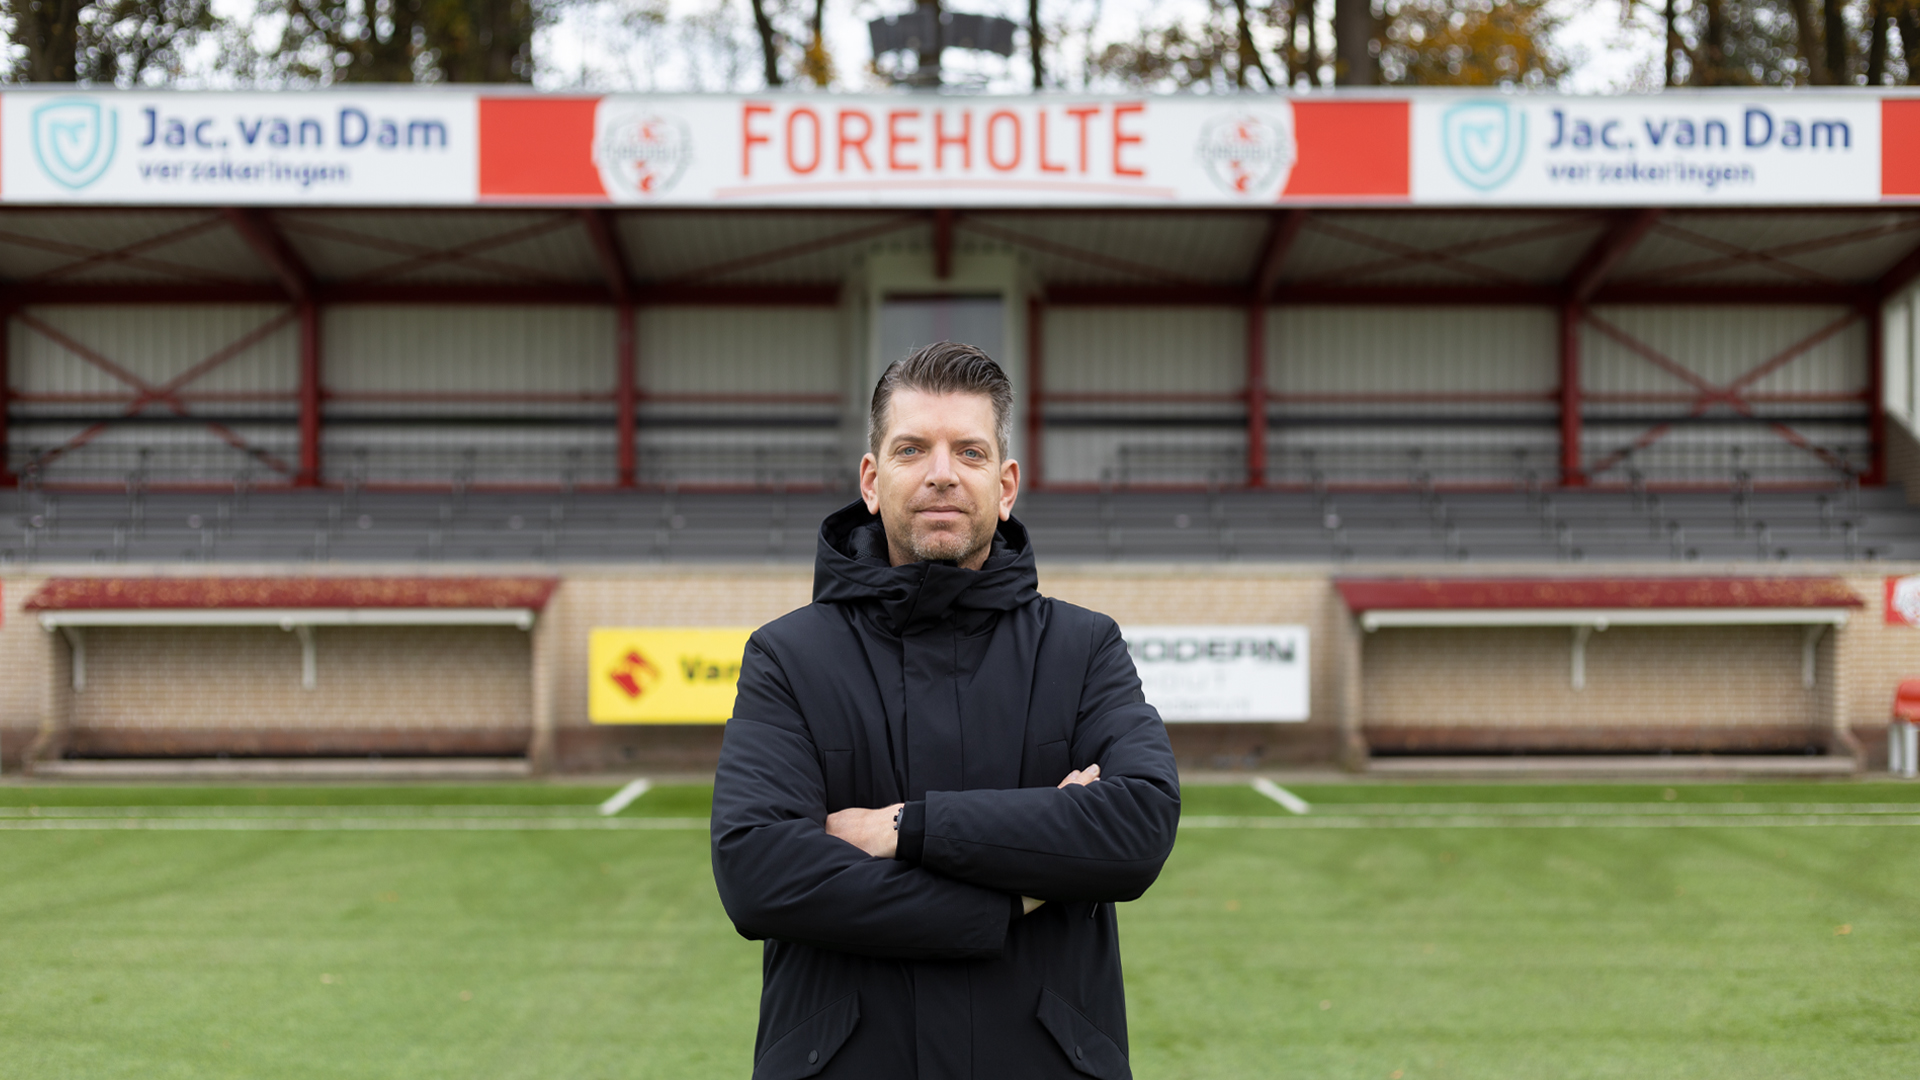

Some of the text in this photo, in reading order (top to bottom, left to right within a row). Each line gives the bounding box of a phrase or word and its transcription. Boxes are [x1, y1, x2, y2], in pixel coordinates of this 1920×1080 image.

[140, 107, 448, 149] Jac. van Dam
[741, 103, 1147, 177] FOREHOLTE
[1549, 107, 1851, 149] Jac. van Dam
[140, 161, 349, 188] verzekeringen
[1547, 161, 1754, 188] verzekeringen
